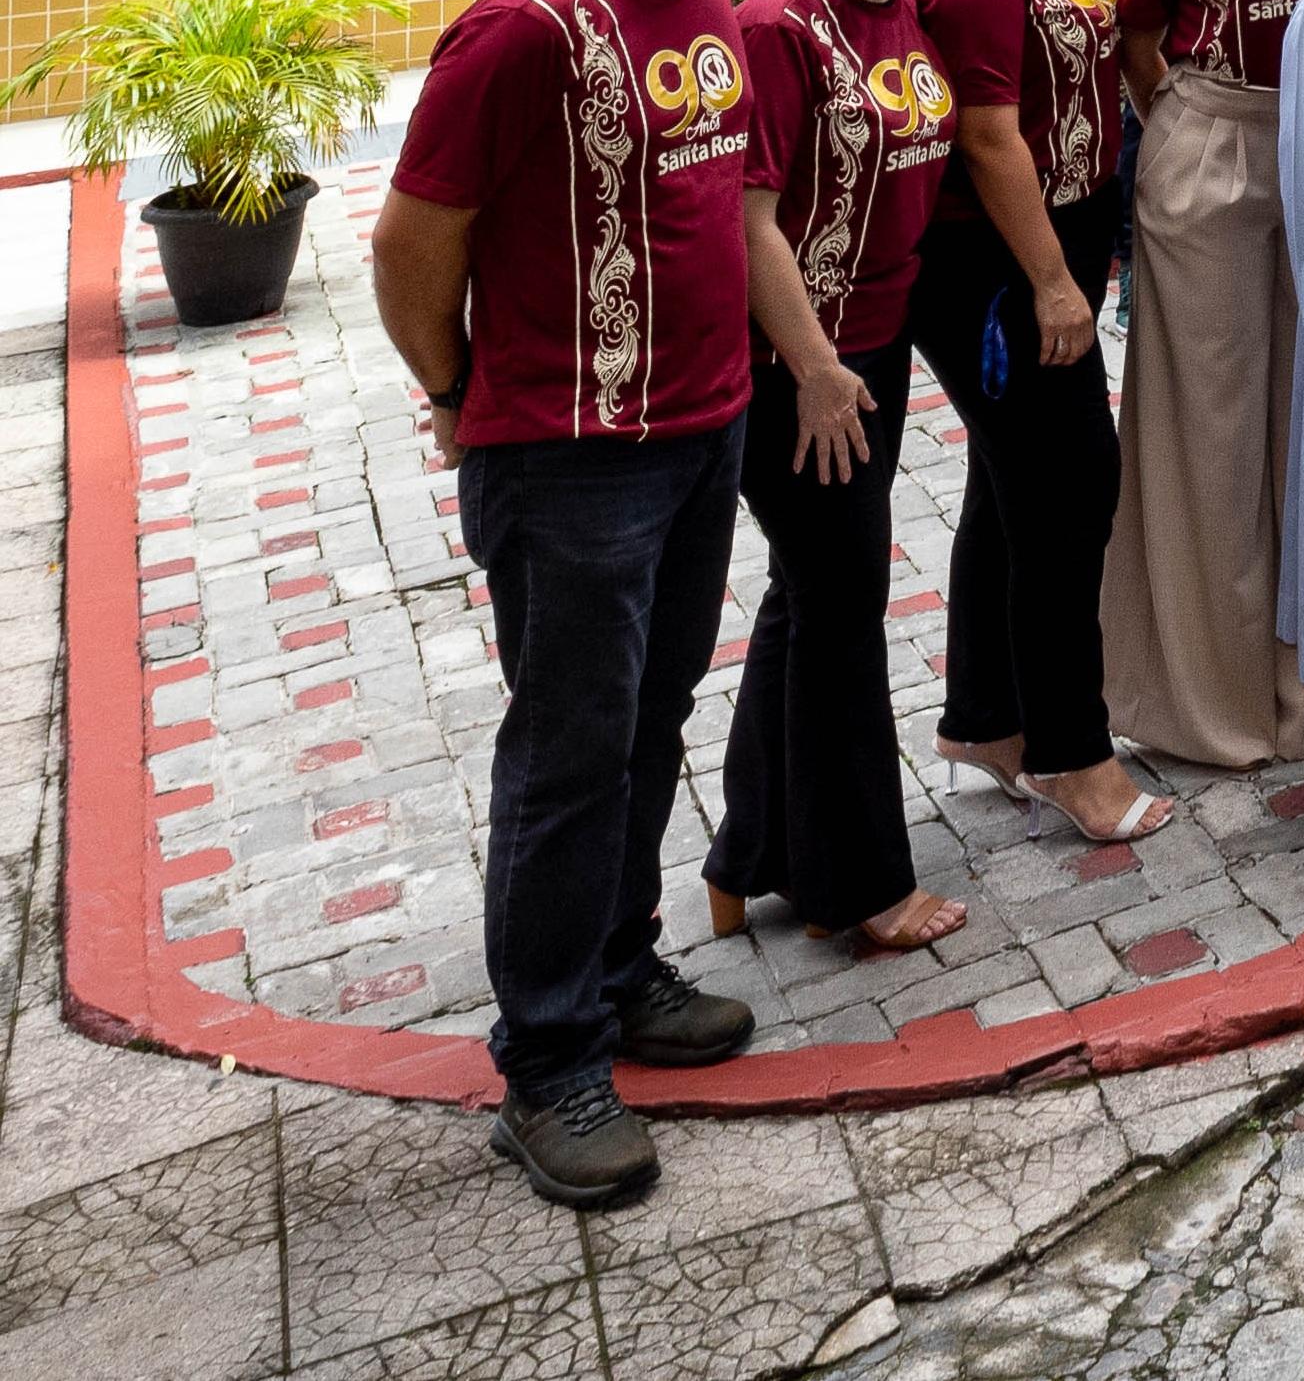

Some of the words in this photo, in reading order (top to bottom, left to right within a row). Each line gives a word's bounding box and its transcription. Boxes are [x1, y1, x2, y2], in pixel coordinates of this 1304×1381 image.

[657, 142, 709, 176] Santa
[886, 145, 927, 172] Santa
[929, 140, 951, 161] Ros
